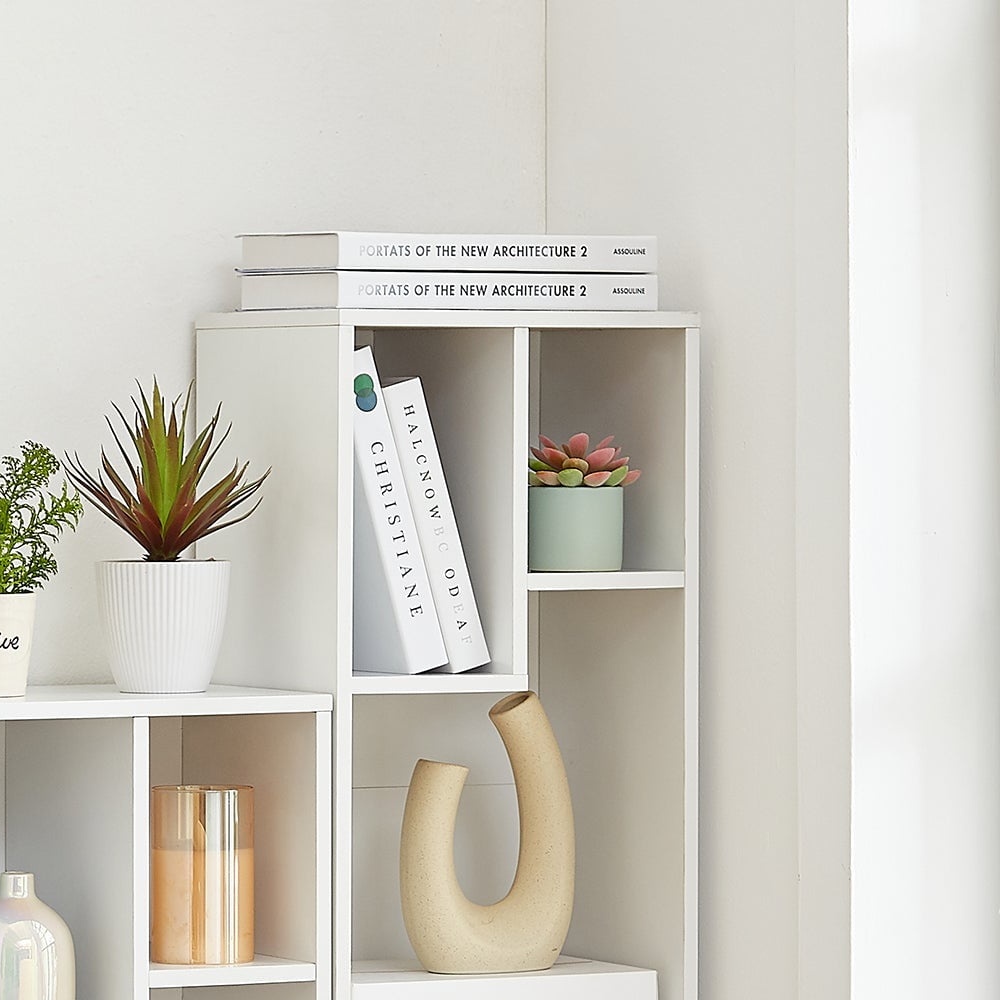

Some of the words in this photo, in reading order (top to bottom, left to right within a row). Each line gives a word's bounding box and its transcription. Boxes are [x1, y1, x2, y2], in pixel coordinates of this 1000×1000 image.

[359, 245, 411, 257] PORTATS
[415, 245, 432, 257] OF
[436, 245, 457, 257] THE
[461, 245, 489, 257] NEW
[493, 245, 576, 257] ARCHITECTURE
[580, 245, 588, 257] 2
[358, 284, 410, 296] PORTATS
[414, 284, 431, 296] OF
[434, 284, 456, 296] THE
[460, 284, 488, 297] NEW
[491, 285, 576, 297] ARCHITECTURE
[579, 285, 587, 297] 2
[370, 441, 424, 618] CHRISTIANE
